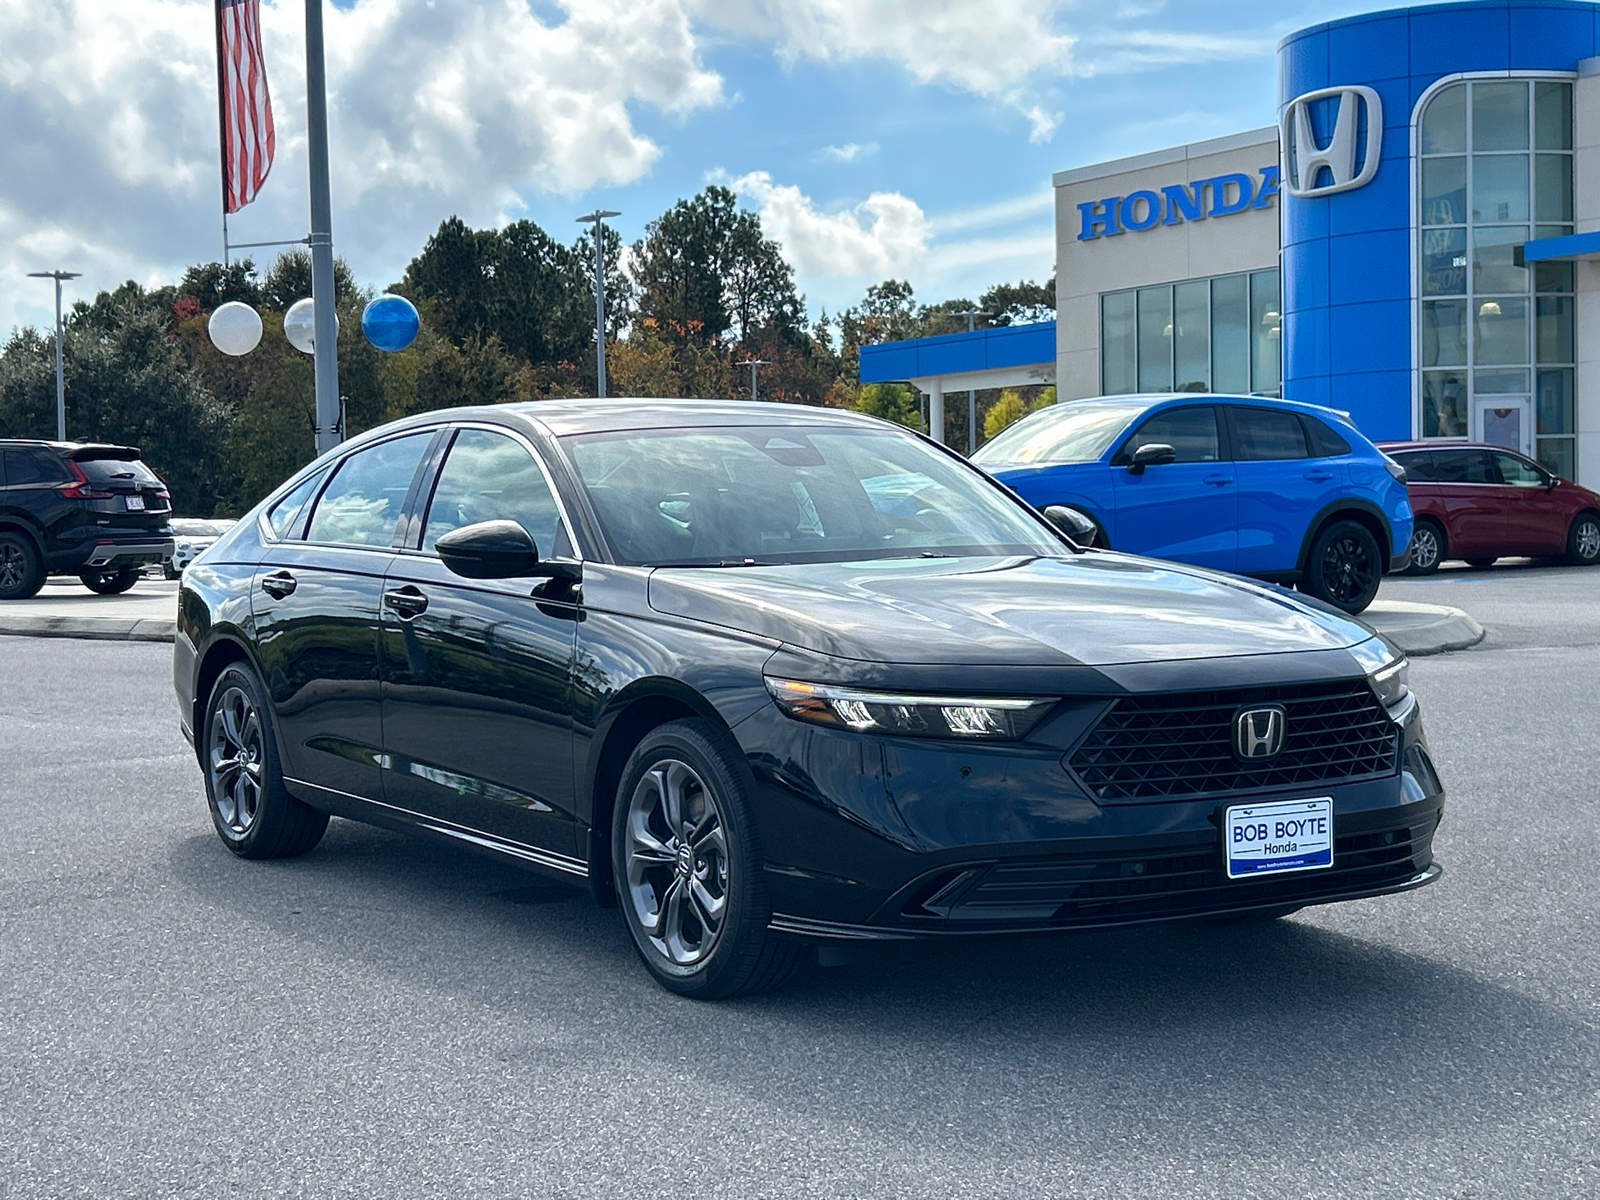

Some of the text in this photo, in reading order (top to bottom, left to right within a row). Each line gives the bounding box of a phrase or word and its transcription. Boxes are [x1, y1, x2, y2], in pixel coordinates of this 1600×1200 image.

[1076, 165, 1279, 241] HONDA
[1233, 817, 1327, 843] BOB BOYTE
[1264, 841, 1298, 855] Honda
